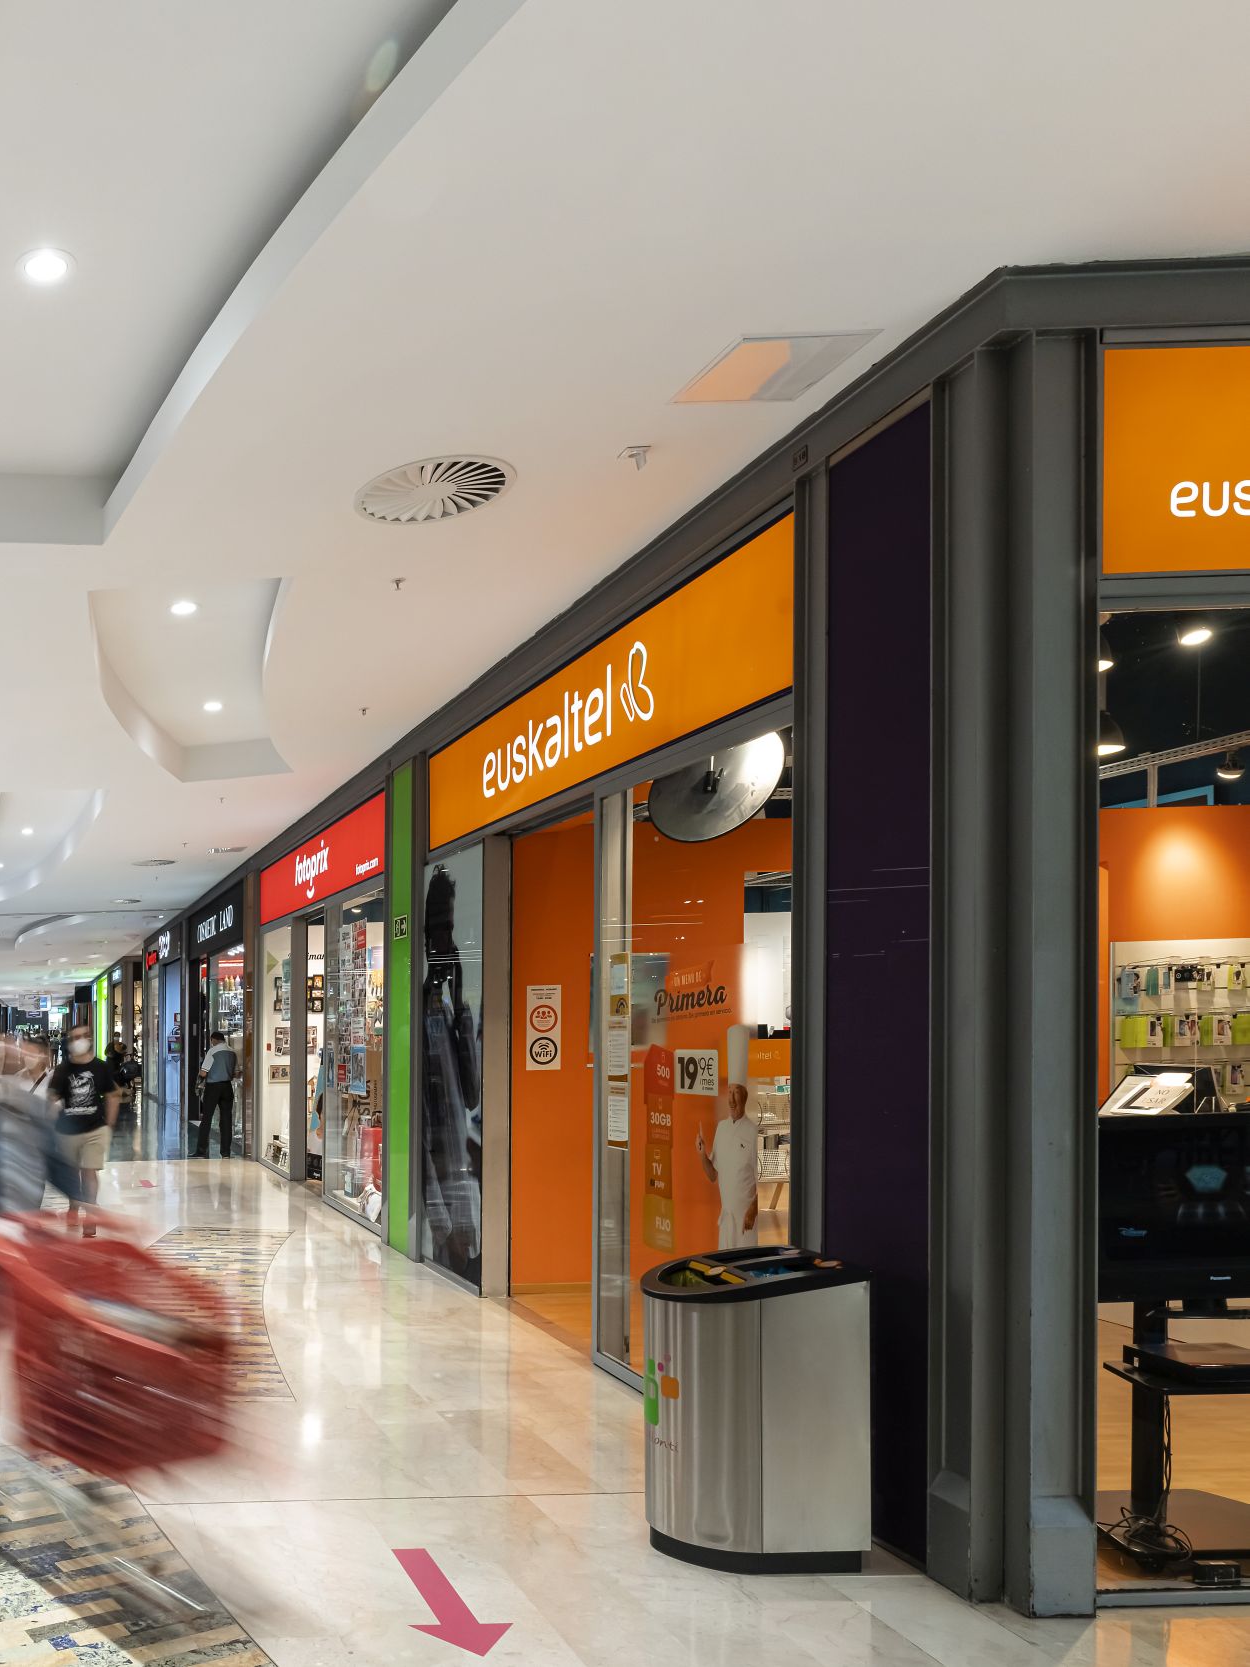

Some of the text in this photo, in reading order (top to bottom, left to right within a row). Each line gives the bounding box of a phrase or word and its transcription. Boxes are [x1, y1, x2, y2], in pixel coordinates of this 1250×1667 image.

[1169, 480, 1250, 517] eus
[482, 663, 612, 798] euskaltel
[294, 839, 329, 887] fotoprix
[219, 904, 234, 932] LAND
[654, 985, 728, 1016] Primera
[534, 1050, 552, 1058] WiFi
[757, 1051, 772, 1060] ltel
[656, 1064, 670, 1080] 500
[650, 1112, 671, 1127] 30GB
[652, 1162, 662, 1176] TV
[655, 1216, 671, 1232] FIJO
